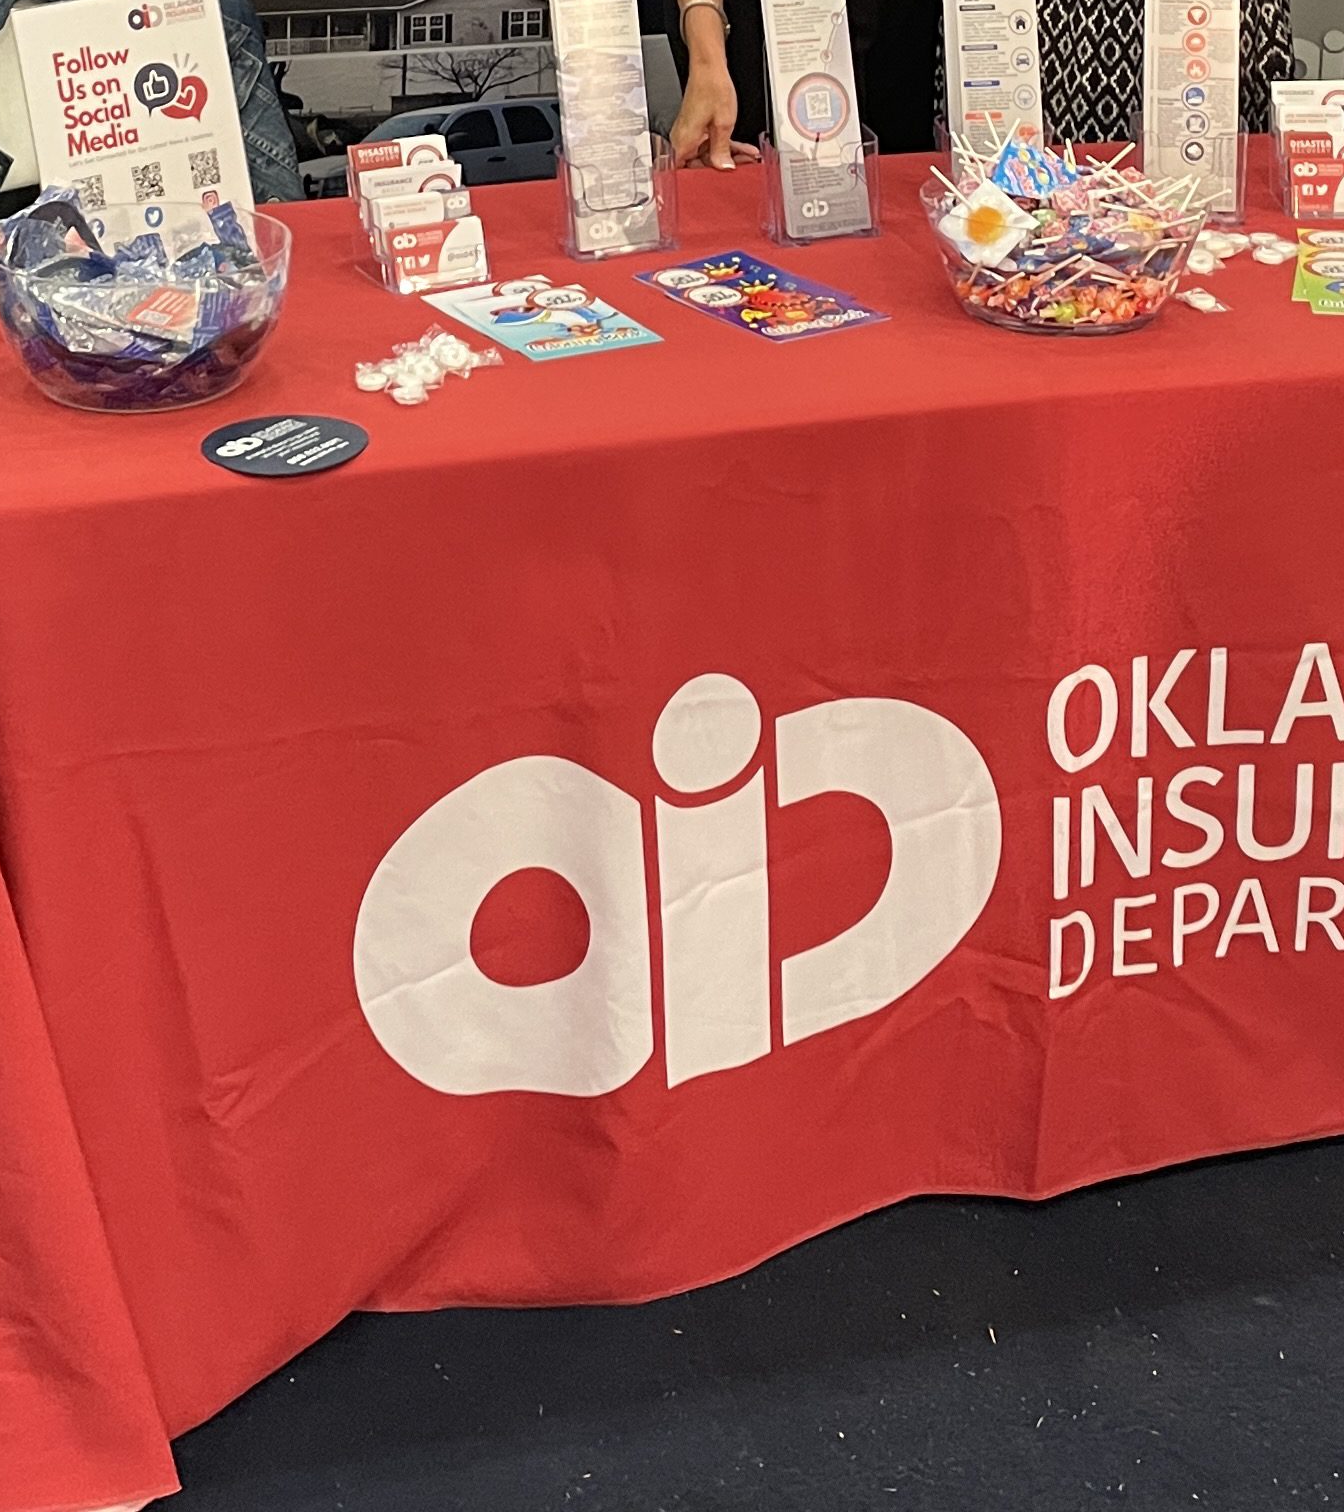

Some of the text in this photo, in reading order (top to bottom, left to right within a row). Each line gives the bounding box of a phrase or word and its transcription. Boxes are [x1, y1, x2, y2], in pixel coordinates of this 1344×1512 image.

[52, 46, 130, 77] Follow
[57, 78, 121, 104] Us on
[63, 96, 131, 130] Social
[66, 125, 140, 157] Media
